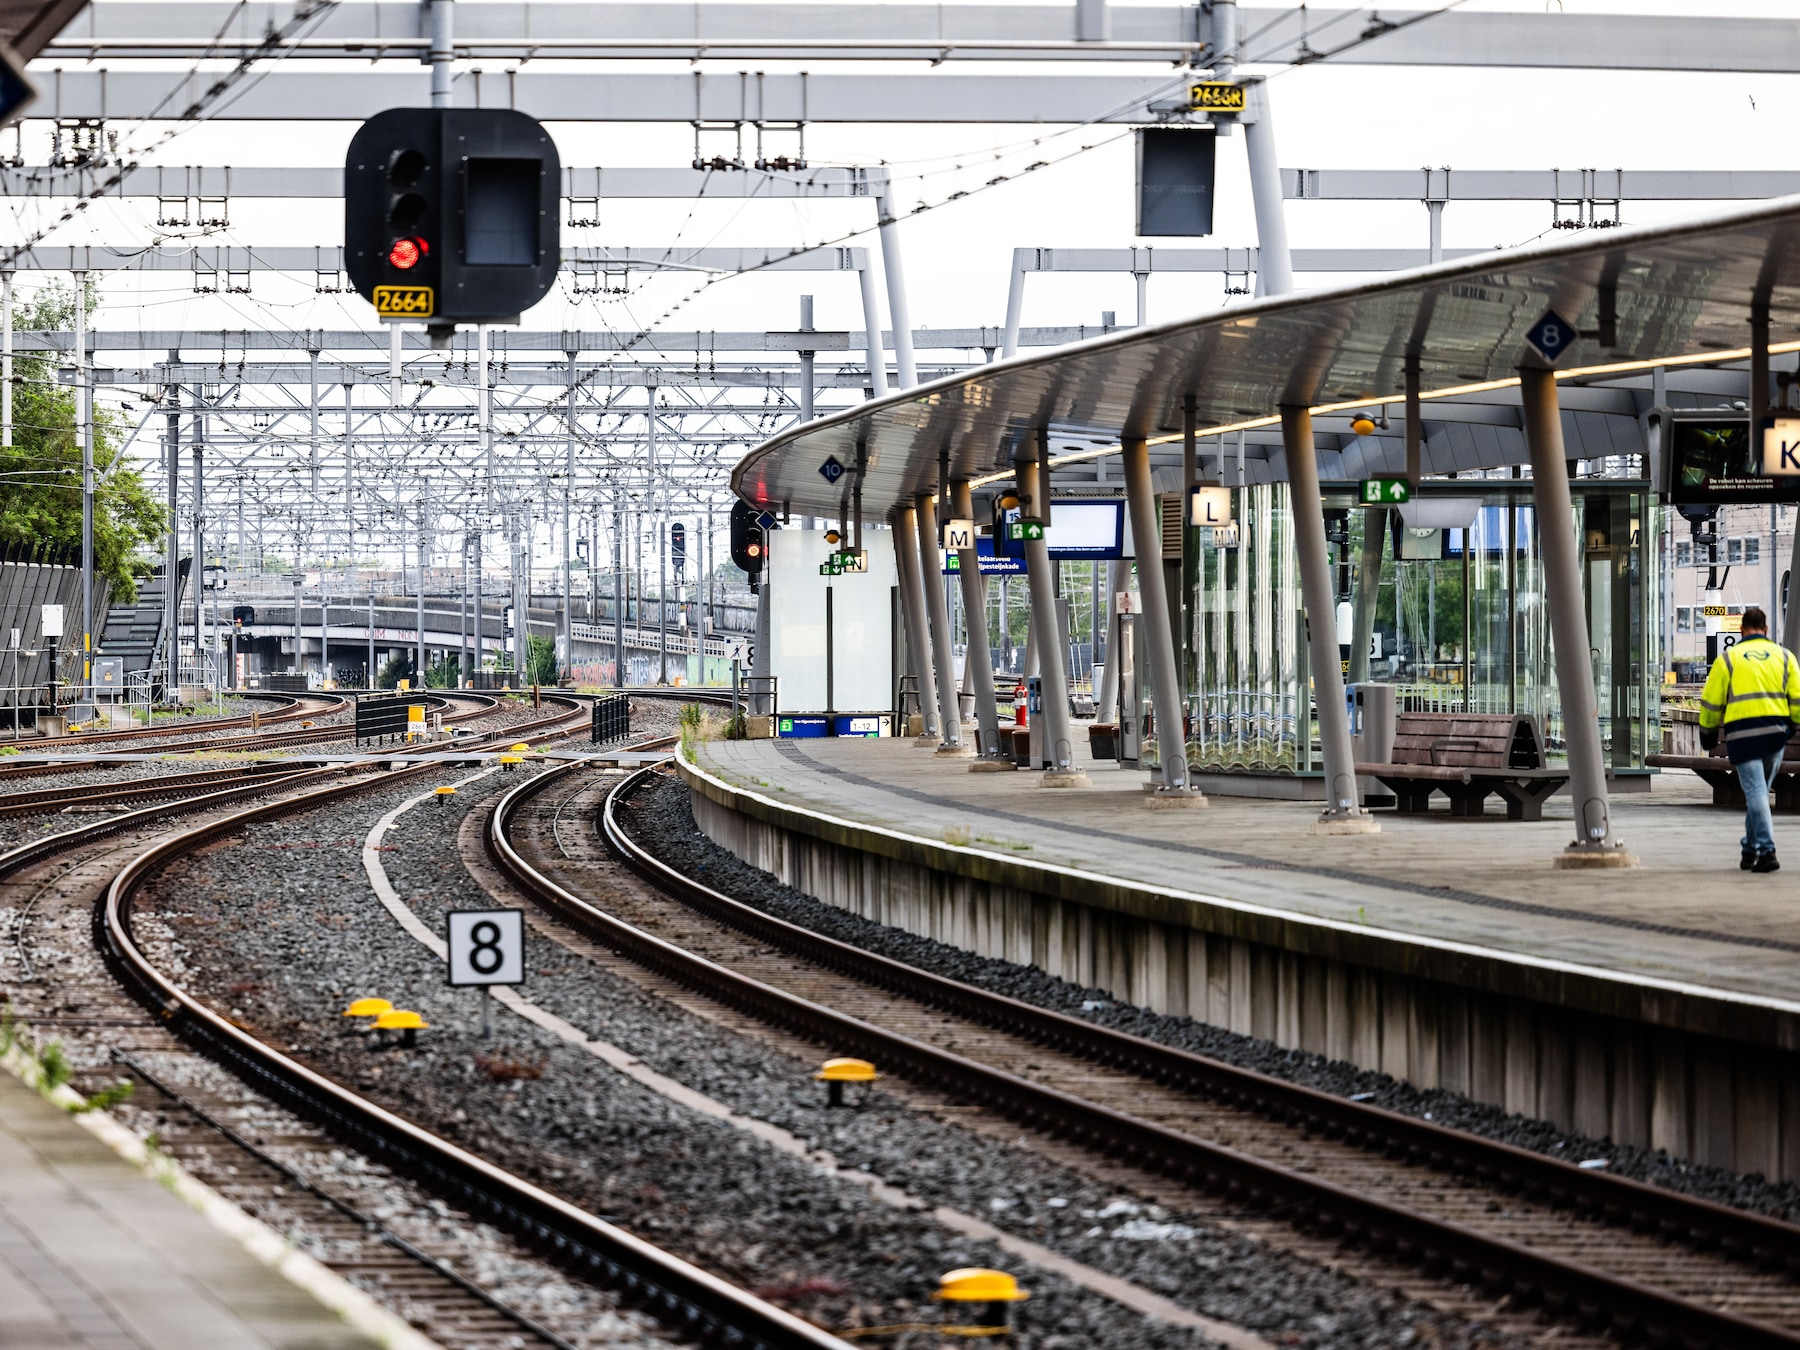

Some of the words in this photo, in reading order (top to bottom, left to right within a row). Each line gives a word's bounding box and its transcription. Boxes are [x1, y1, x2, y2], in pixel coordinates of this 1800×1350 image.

[379, 291, 427, 312] 2664
[1542, 324, 1560, 347] 8
[1781, 440, 1800, 469] K
[825, 464, 840, 477] 10
[1207, 502, 1218, 521] L
[950, 531, 968, 547] M
[852, 558, 862, 570] N
[978, 563, 1020, 571] ijpesteijnkade
[1705, 607, 1724, 615] 2670
[469, 920, 504, 975] 8
